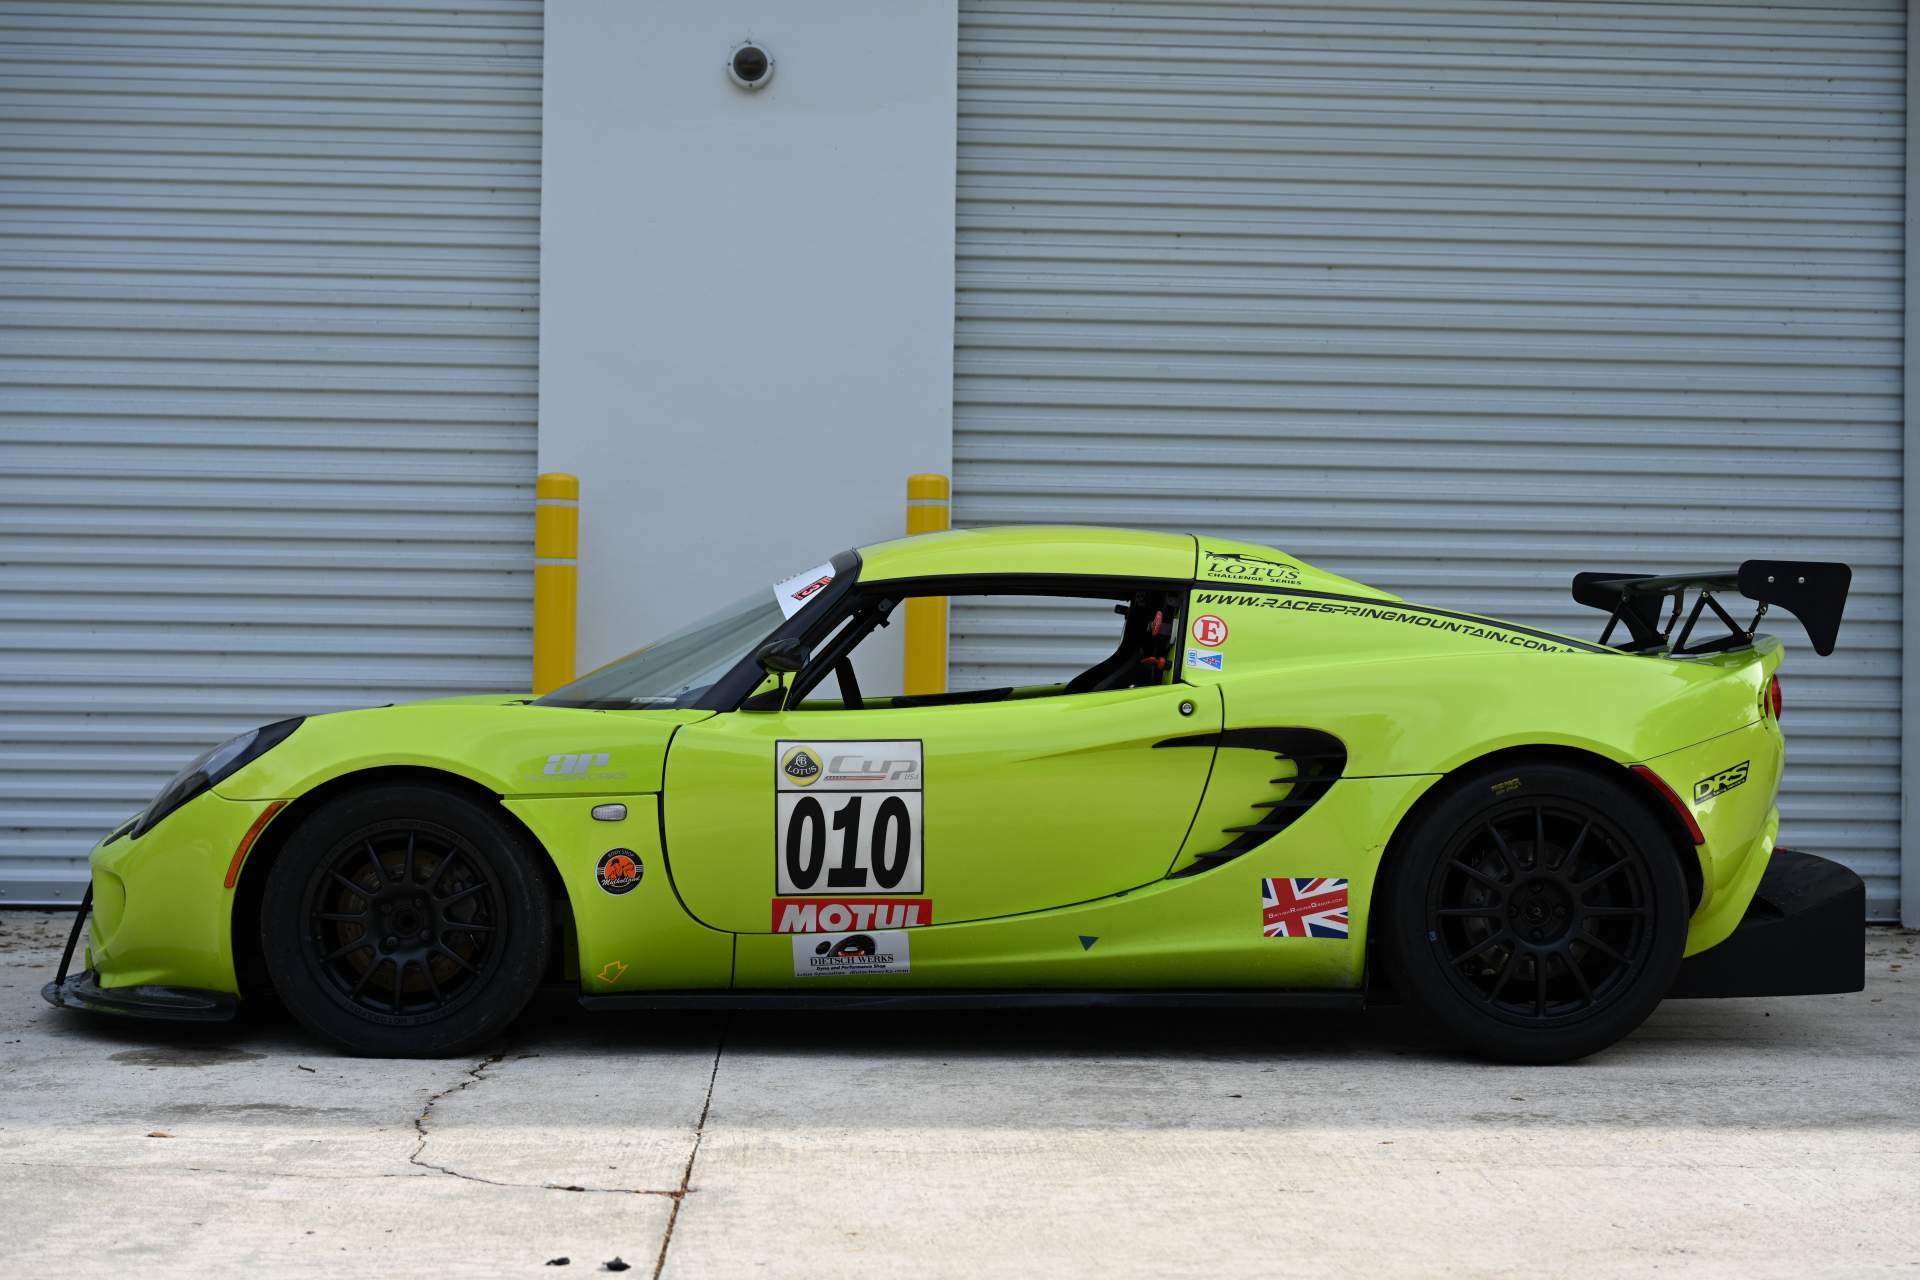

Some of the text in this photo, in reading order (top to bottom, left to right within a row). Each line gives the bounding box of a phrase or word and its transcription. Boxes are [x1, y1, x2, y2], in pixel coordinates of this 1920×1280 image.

[1207, 572, 1264, 582] CHALLENGE
[1208, 563, 1300, 580] LOTUS
[1196, 593, 1557, 653] WWW.RACESPRINGMOUNTAIN.COM
[1199, 619, 1220, 643] E
[787, 764, 818, 775] LOTUS
[1695, 764, 1749, 801] DRS
[786, 796, 911, 890] 010
[778, 903, 926, 933] MOTUL
[810, 954, 894, 967] DIETSCH WERKS
